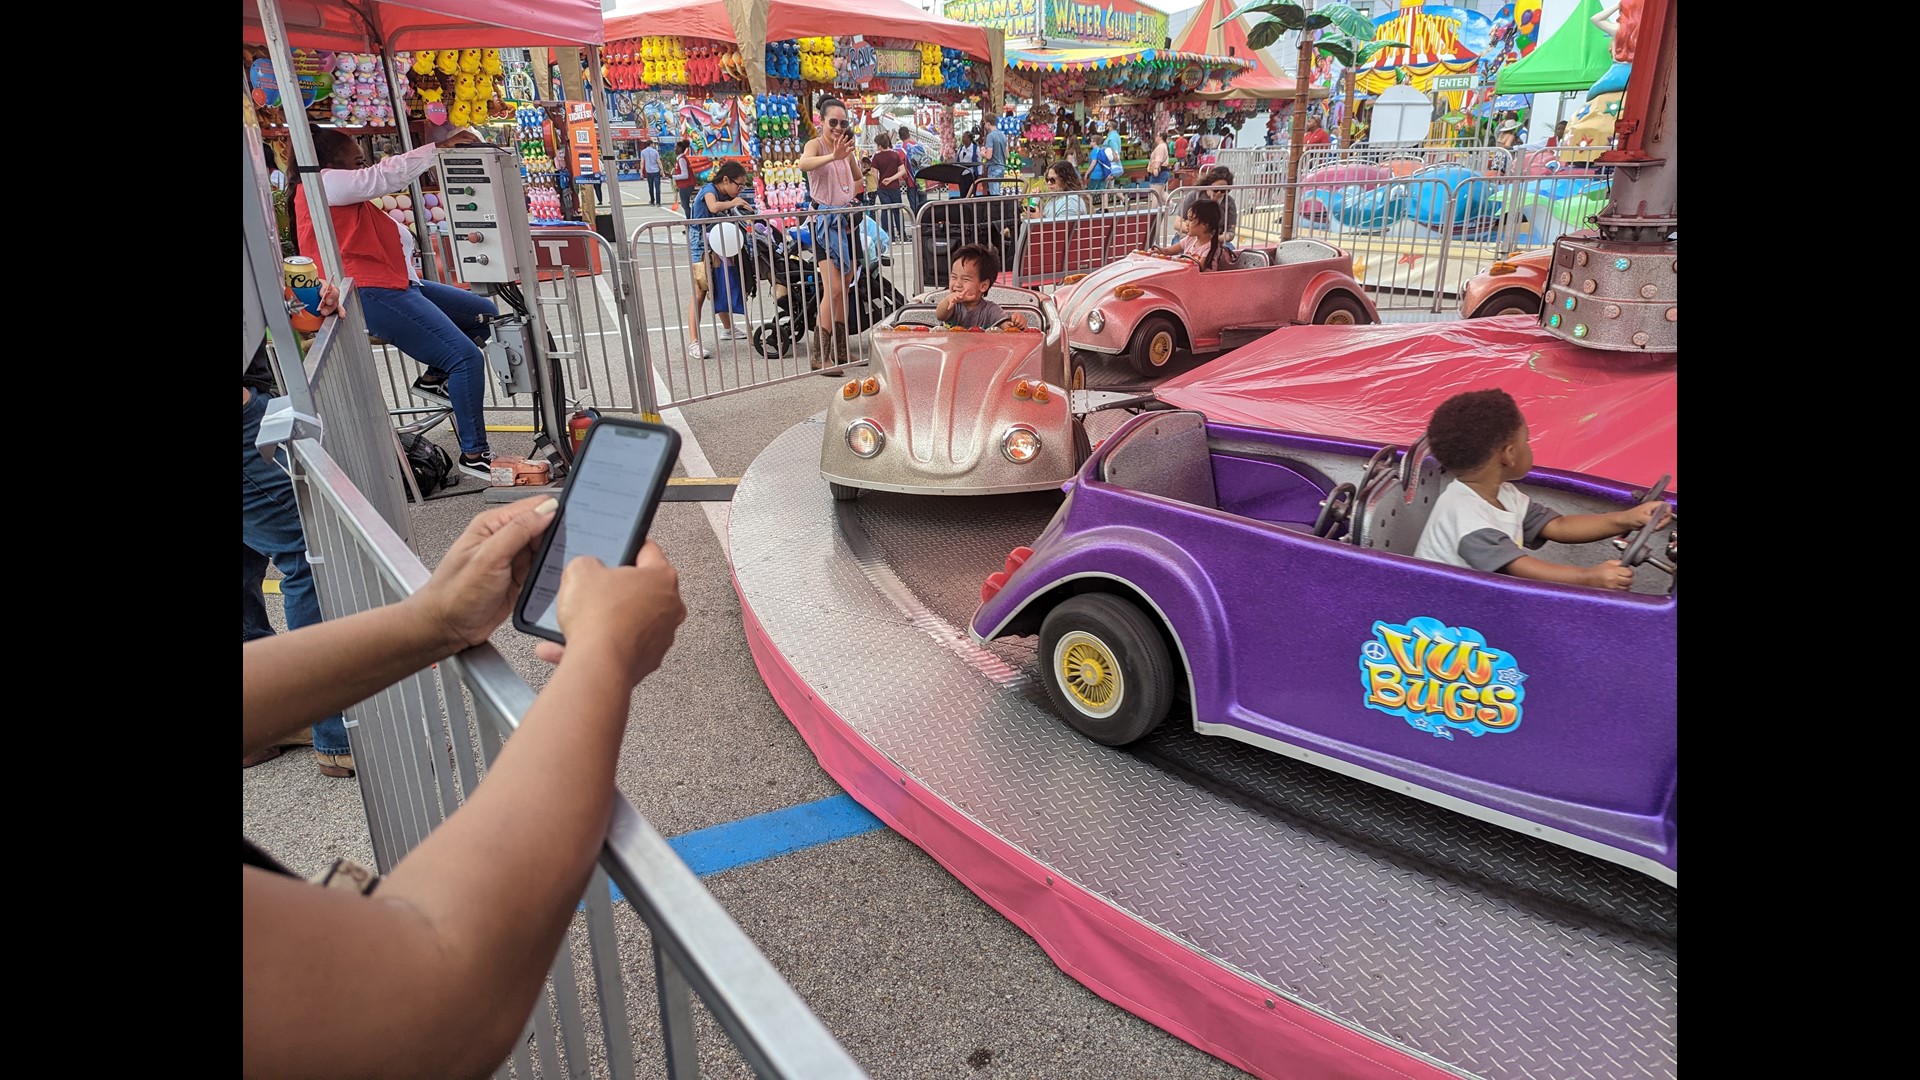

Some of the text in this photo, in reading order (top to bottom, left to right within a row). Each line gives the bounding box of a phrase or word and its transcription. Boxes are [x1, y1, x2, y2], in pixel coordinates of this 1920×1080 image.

[949, 0, 1036, 21] WINNER
[1053, 0, 1158, 44] WATER GUN FUN
[1411, 13, 1461, 55] HOUSE
[1439, 77, 1469, 87] ENTER
[568, 110, 592, 122] TICKETS!
[574, 103, 586, 113] BUY
[1376, 624, 1499, 686] VW
